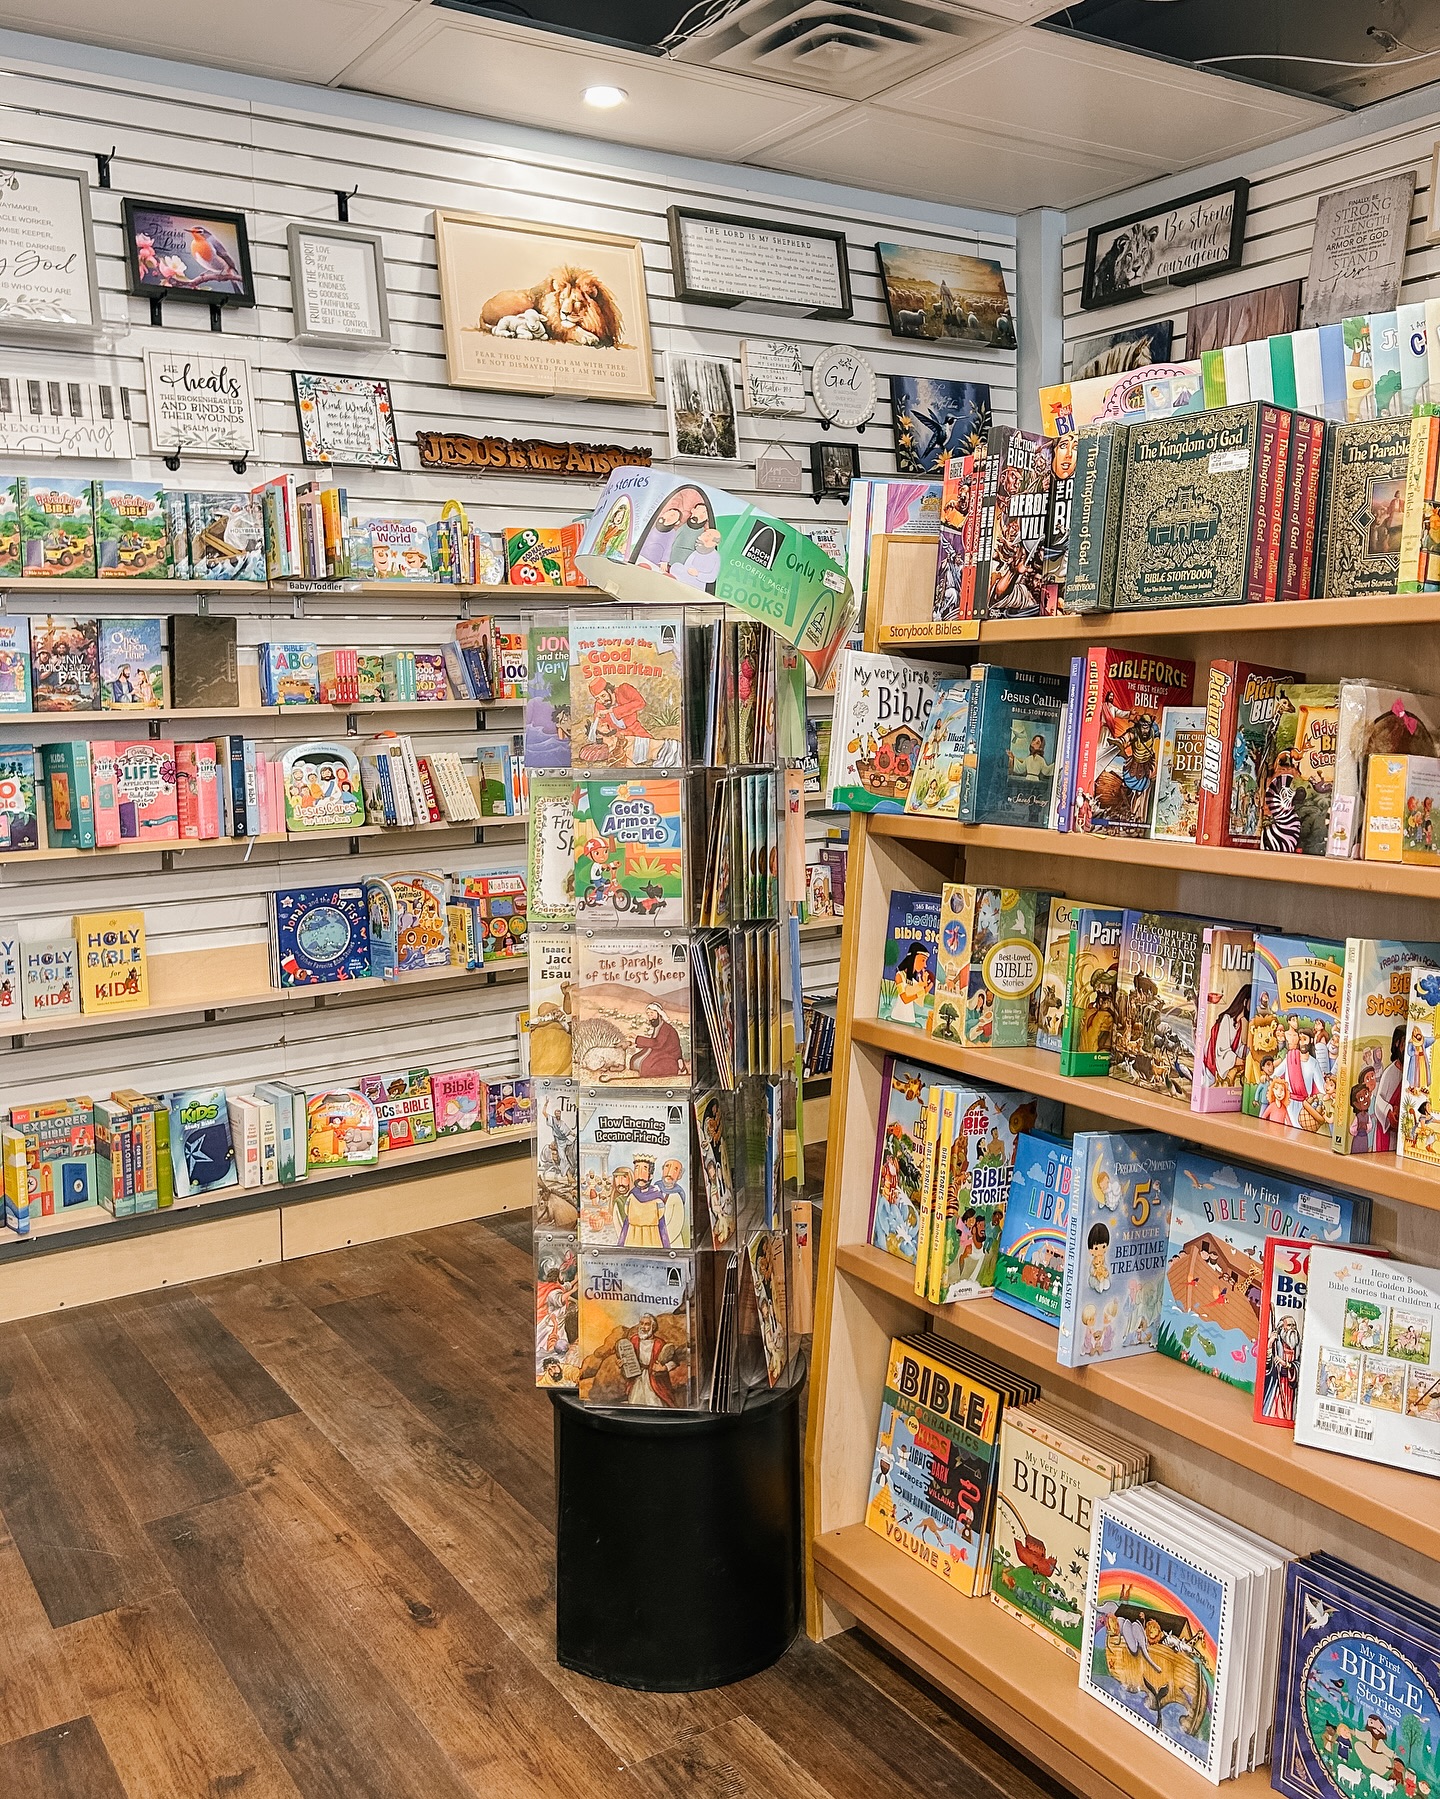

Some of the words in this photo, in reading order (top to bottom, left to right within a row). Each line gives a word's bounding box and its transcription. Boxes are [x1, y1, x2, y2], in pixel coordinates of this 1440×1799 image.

[1334, 197, 1391, 222] STRONG
[1164, 212, 1186, 242] Be
[1190, 204, 1233, 232] strong
[1331, 214, 1391, 238] STRENGTH
[704, 226, 719, 236] THE
[723, 229, 745, 239] LORD
[749, 233, 755, 241] IS
[773, 237, 811, 249] SHEPHERD
[1326, 238, 1354, 252] ARMOR
[1356, 236, 1367, 245] OF
[1369, 229, 1388, 242] GOD
[304, 242, 315, 266] SPIRIT
[1157, 244, 1229, 277] courageous
[1333, 250, 1378, 270] STAND
[306, 269, 317, 283] THE
[318, 272, 344, 283] PATIENCE
[308, 289, 318, 299] OF
[319, 281, 346, 291] KINDNESS
[320, 290, 349, 300] GOODNESS
[320, 299, 360, 310] FAITHFULNESS
[308, 302, 320, 324] FRUIT
[321, 308, 356, 318] GENTLENESS
[825, 365, 862, 390] God
[160, 394, 175, 402] THE
[177, 394, 243, 406] BROKENHEARTED
[160, 401, 188, 412] AND
[191, 403, 225, 415] BINDS
[229, 406, 244, 414] UP
[162, 411, 193, 421] THEIR
[197, 413, 245, 424] WOUNDS
[1140, 443, 1157, 460] The
[1159, 438, 1205, 459] Kingdom
[1206, 433, 1218, 452] of
[1219, 428, 1243, 446] God
[1008, 450, 1035, 470] BIBLE
[44, 504, 74, 514] BIBLE
[119, 506, 147, 516] BIBLE
[392, 524, 417, 534] Made
[377, 533, 411, 543] World
[746, 553, 769, 568] BOOKS
[749, 546, 770, 560] ARCH
[1144, 572, 1166, 584] BIBLE
[1167, 568, 1213, 581] STORYBOOK
[289, 582, 342, 591] Baby/Toddler
[890, 625, 933, 637] Storybook
[936, 624, 962, 635] Bibles
[578, 641, 595, 649] The
[598, 638, 622, 647] Story
[625, 637, 635, 645] of
[637, 638, 653, 648] the
[276, 653, 313, 670] ABC
[588, 649, 632, 663] Good
[58, 671, 90, 685] BIBLE
[537, 662, 567, 681] Very
[582, 662, 663, 678] Samaritan
[854, 666, 872, 685] My
[874, 668, 899, 684] very
[901, 668, 930, 688] first
[1109, 659, 1187, 688] BIBLEFORCE
[1085, 661, 1098, 724] BIBLEFORCE
[878, 686, 932, 723] Bible
[1134, 693, 1159, 709] BIBLE
[1209, 668, 1227, 737] Picture
[1028, 708, 1058, 718] STORYBOOK
[50, 754, 65, 763] KIDS
[1202, 736, 1221, 794] BIBLE
[125, 765, 158, 780] LIFE
[295, 803, 325, 817] Jesus
[327, 802, 357, 813] Cares
[614, 803, 650, 815] God's
[604, 817, 657, 832] Armor
[621, 831, 638, 840] for
[641, 827, 664, 840] Me
[87, 928, 140, 948] HOLY
[1131, 931, 1197, 950] ILLUSTRATED
[1132, 923, 1147, 933] THE
[1152, 926, 1198, 942] COMPLETE
[28, 950, 72, 966] HOLY
[87, 947, 142, 968] BIBLE
[542, 946, 566, 954] Isaac
[998, 953, 1031, 962] Best-Loved
[1130, 939, 1195, 962] CHILDREN'S
[995, 962, 1033, 978] BIBLE
[1127, 950, 1195, 988] BIBLE
[1305, 958, 1313, 966] My
[109, 970, 121, 978] for
[541, 969, 571, 979] Esau
[586, 971, 599, 981] of
[602, 972, 620, 981] the
[624, 971, 649, 982] Lost
[653, 969, 686, 984] Sheep
[95, 981, 139, 999] KIDS
[1002, 979, 1024, 987] Stories
[1290, 970, 1337, 998] Bible
[34, 991, 72, 1009] KIDS
[1286, 992, 1338, 1013] Storybook
[443, 1079, 475, 1095] Bible
[403, 1098, 430, 1112] BIBLE
[22, 1114, 88, 1134] EXPLORER
[599, 1116, 621, 1128] How
[623, 1117, 665, 1131] Enemies
[964, 1117, 989, 1129] BIG
[40, 1127, 71, 1140] BIBLE
[595, 1131, 632, 1142] Became
[633, 1132, 670, 1145] Friends
[123, 1133, 132, 1173] EXPLORER
[125, 1174, 133, 1195] BIBLE
[1244, 1182, 1258, 1196] My
[1260, 1186, 1280, 1204] First
[1123, 1227, 1159, 1240] MINUTE
[1115, 1241, 1164, 1259] BEDTIME
[1111, 1255, 1166, 1275] TREASURY
[602, 1268, 618, 1279] The
[591, 1276, 622, 1291] TEN
[1354, 1276, 1375, 1286] Little
[1377, 1281, 1405, 1292] Golden
[1408, 1286, 1428, 1297] Book
[584, 1287, 679, 1306] Commandments
[1328, 1281, 1349, 1291] Bible
[1351, 1287, 1377, 1298] stories
[1380, 1290, 1396, 1301] that
[1398, 1296, 1431, 1309] children
[901, 1356, 984, 1435] BIBLE
[896, 1396, 979, 1450] INFOGRAPHICS
[908, 1421, 918, 1430] FOR
[917, 1428, 948, 1455] KIDS
[1025, 1450, 1037, 1464] My
[1040, 1455, 1058, 1478] Very
[1061, 1469, 1081, 1489] First
[928, 1488, 955, 1509] VILLAINS
[1013, 1459, 1091, 1533] BIBLE
[885, 1520, 939, 1568] VOLUME
[943, 1561, 952, 1577] 2
[1105, 1525, 1122, 1548] My
[1122, 1540, 1179, 1588] BIBLE
[1180, 1565, 1218, 1598] STORIES
[1360, 1643, 1375, 1658] My
[1377, 1653, 1401, 1674] First
[1340, 1646, 1424, 1713] BIBLE
[1356, 1682, 1402, 1719] Stories
